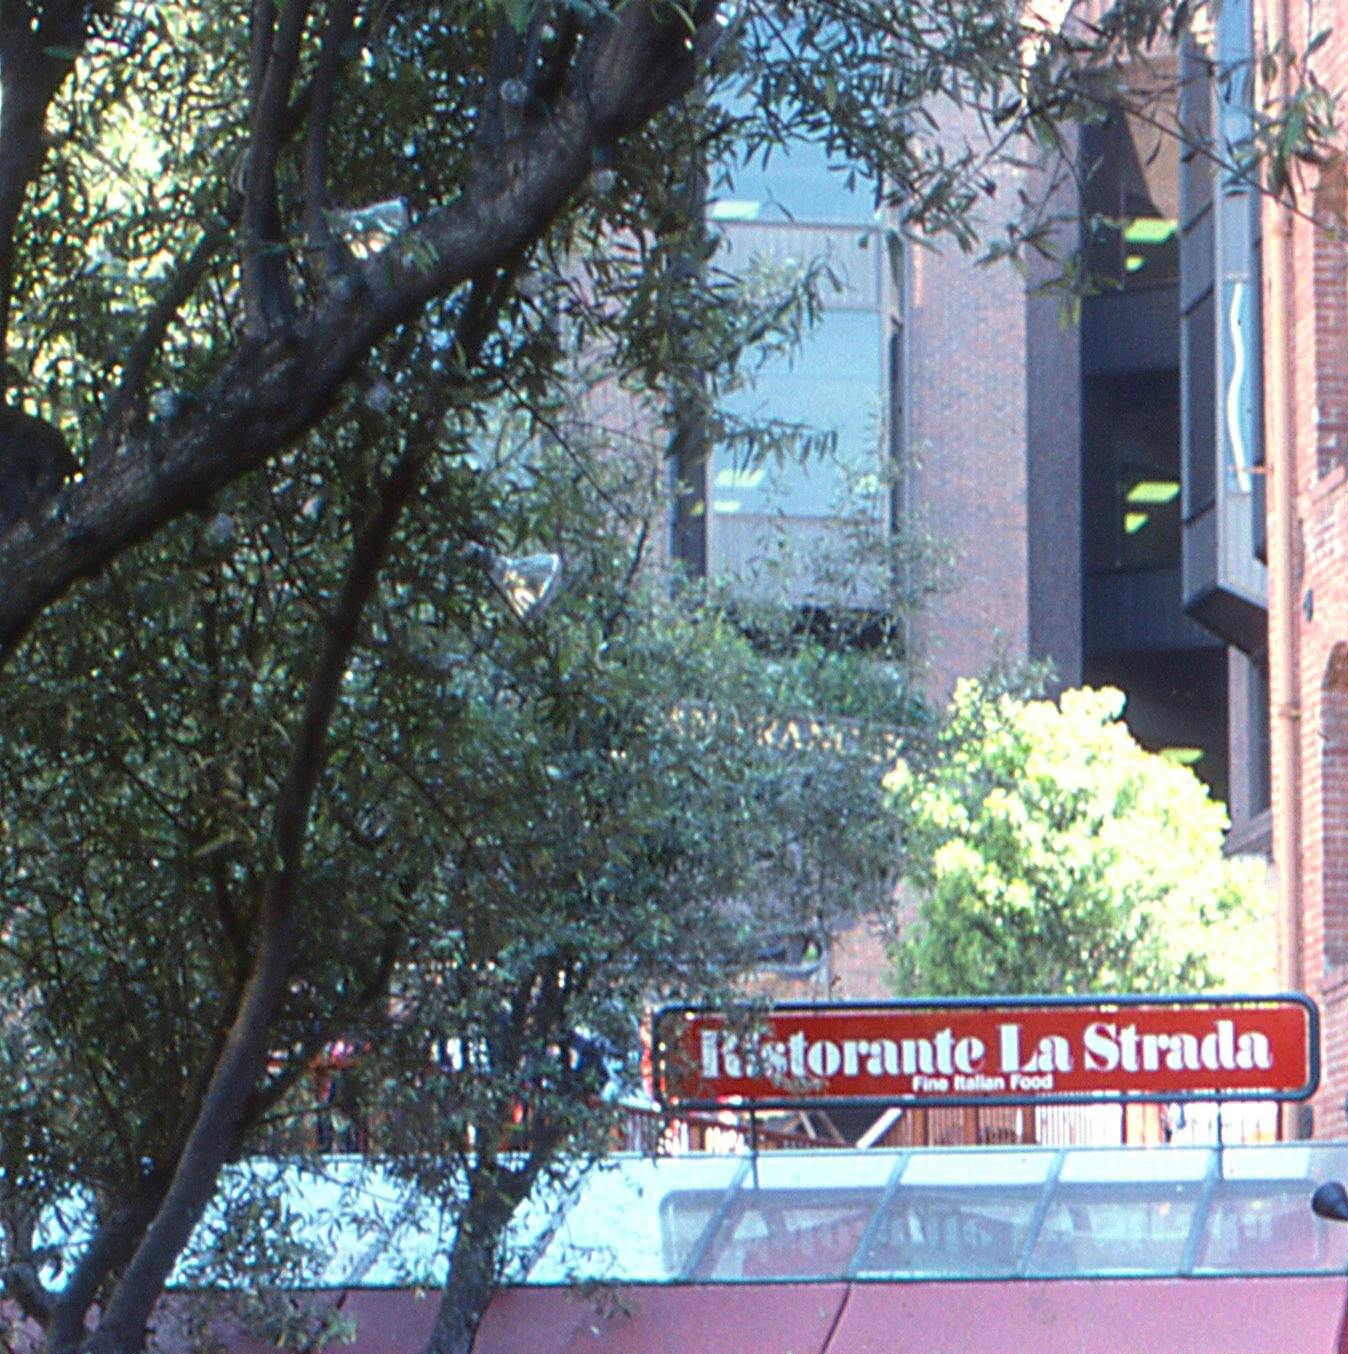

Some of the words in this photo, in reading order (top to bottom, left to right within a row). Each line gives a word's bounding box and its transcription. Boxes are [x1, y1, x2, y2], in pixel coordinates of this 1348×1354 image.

[997, 1023, 1074, 1073] La
[1083, 1019, 1273, 1073] Strada
[912, 1074, 949, 1092] Fine
[954, 1073, 1005, 1091] Italian
[1010, 1072, 1053, 1090] Food
